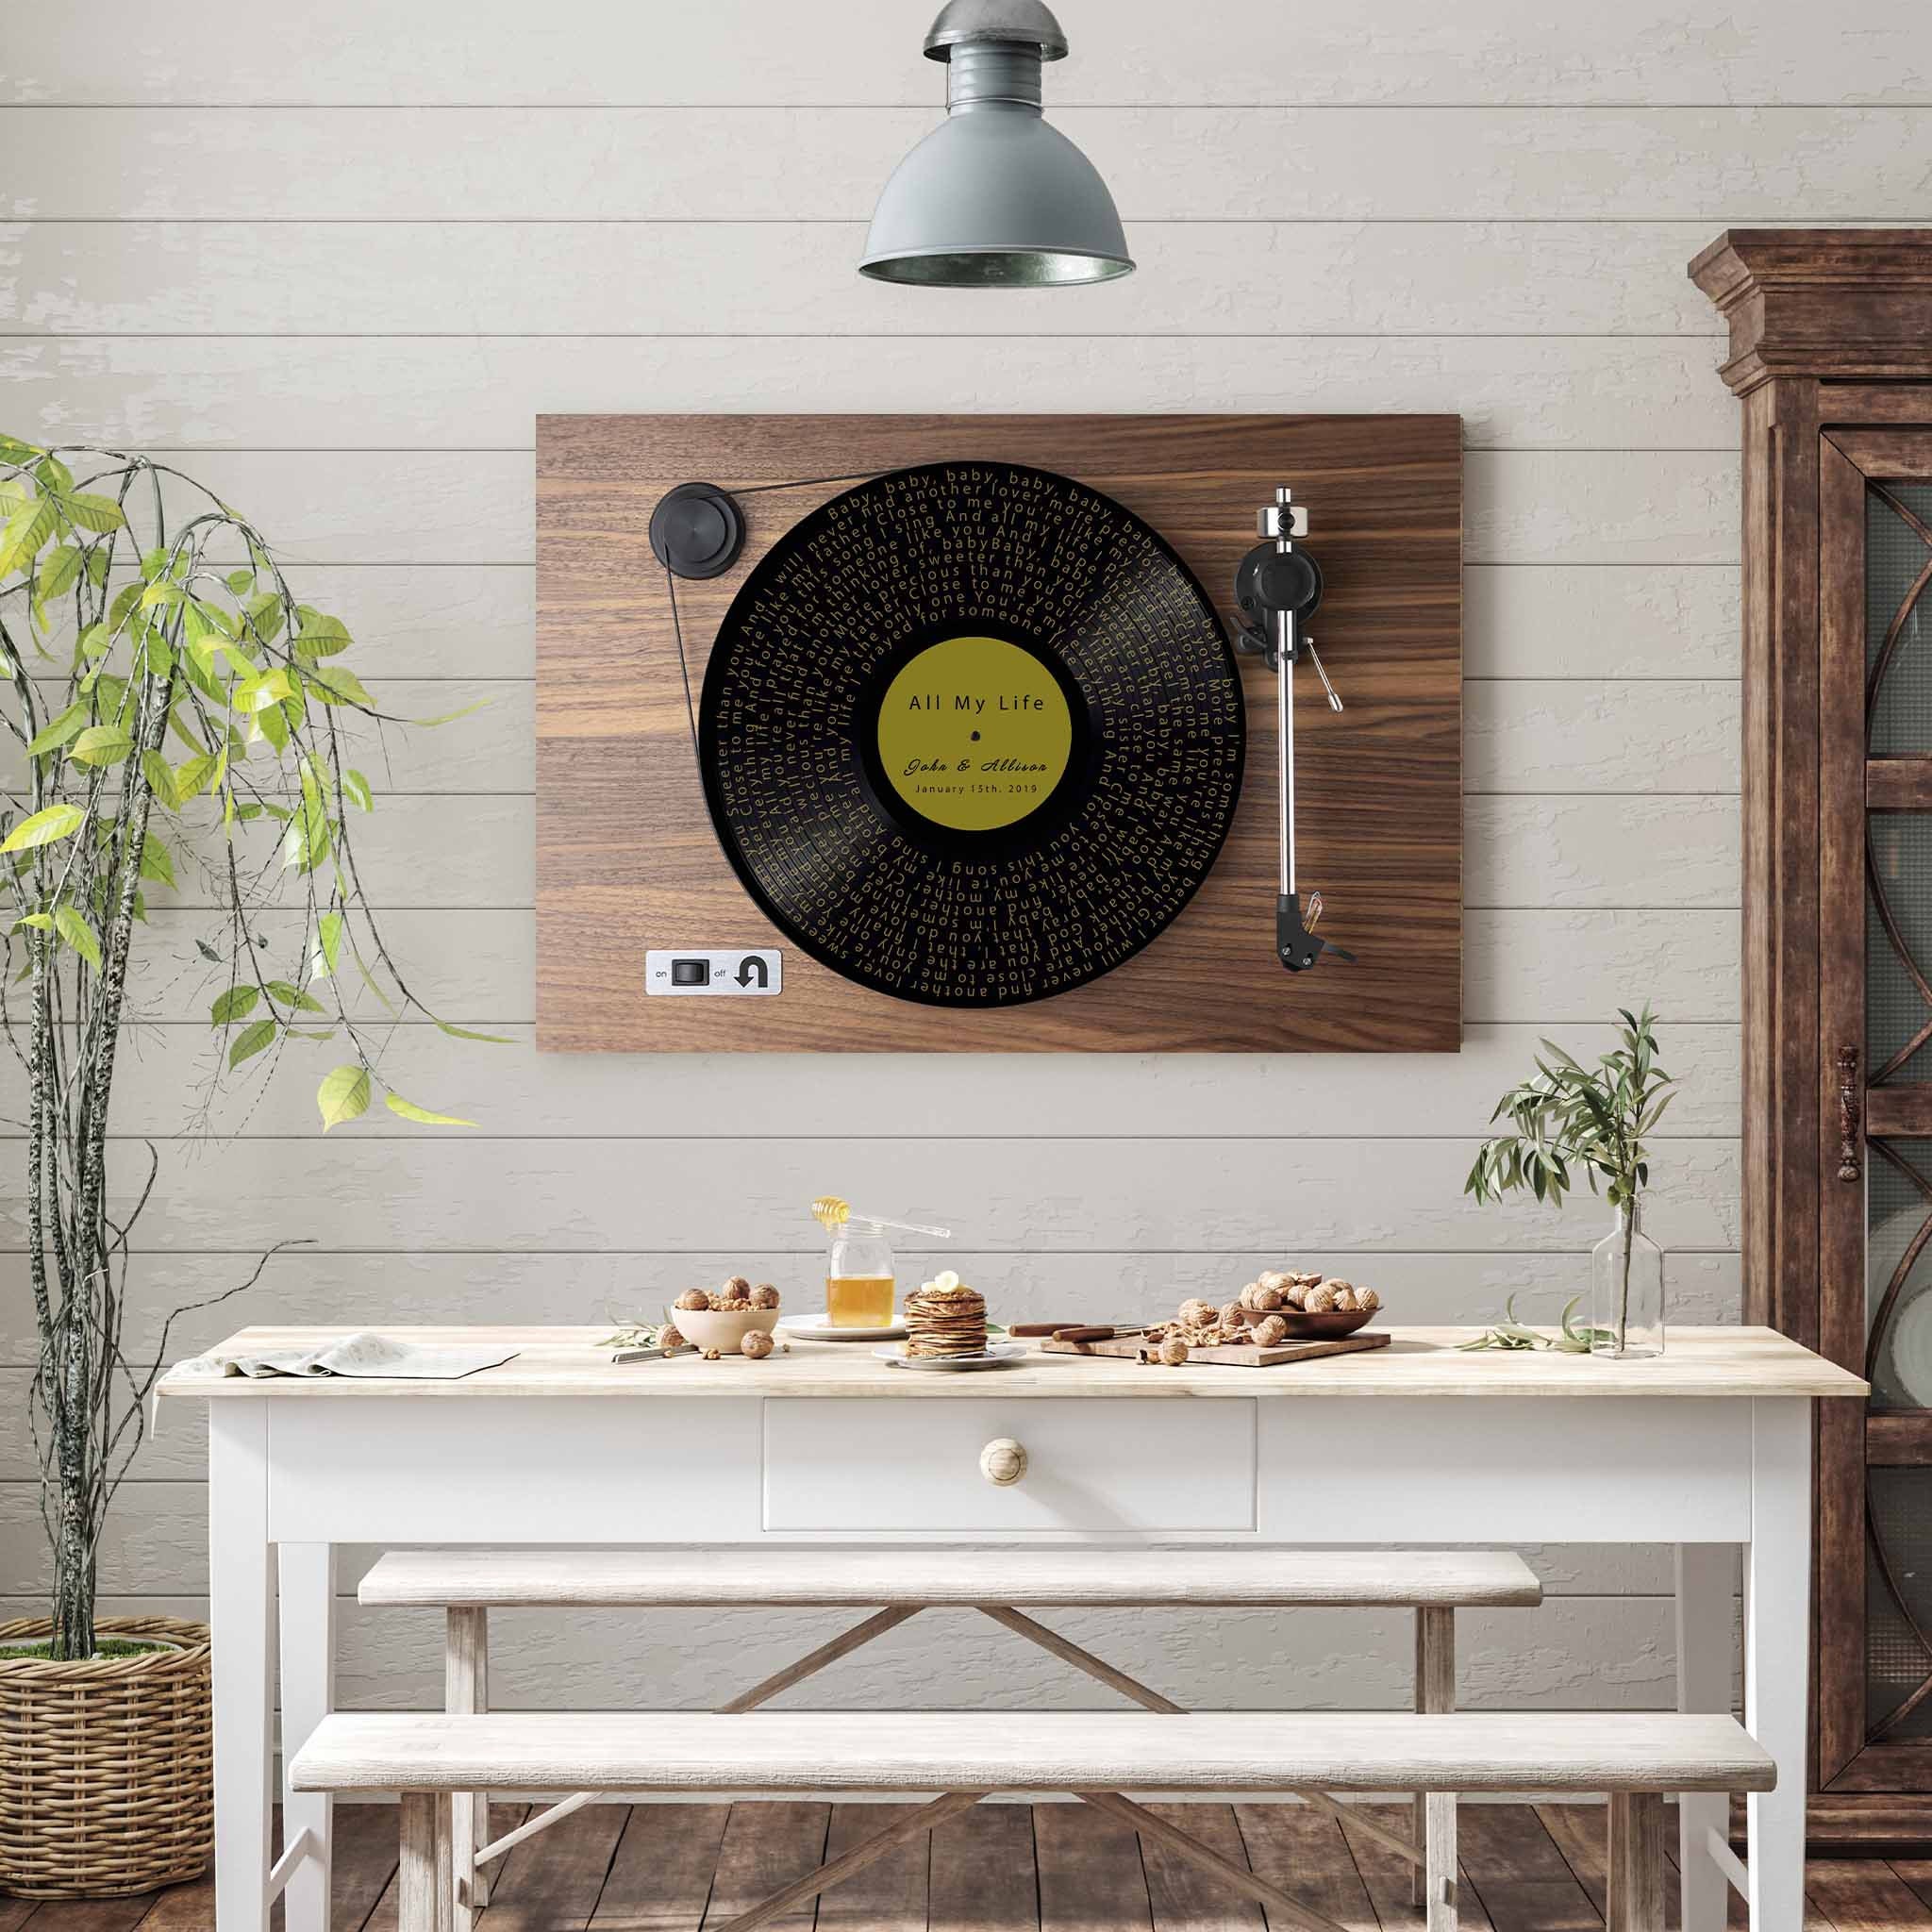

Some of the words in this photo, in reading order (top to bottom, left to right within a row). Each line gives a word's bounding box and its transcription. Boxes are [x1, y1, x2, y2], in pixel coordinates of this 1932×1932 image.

[774, 552, 804, 585] will
[807, 516, 855, 552] never
[859, 495, 895, 518] find
[904, 483, 981, 503] another
[991, 484, 1040, 503] lover
[1048, 499, 1093, 525] more
[1098, 525, 1167, 585] precious
[814, 524, 870, 562] father
[874, 503, 928, 526] Close
[894, 516, 935, 533] sing
[944, 509, 981, 522] And
[991, 512, 1015, 525] all
[1002, 502, 1062, 525] you're
[1070, 520, 1103, 546] like
[1057, 529, 1089, 553] life
[797, 568, 828, 599] this
[832, 537, 874, 567] song
[918, 552, 995, 569] sweeter
[970, 564, 1013, 580] than
[1004, 556, 1047, 577] than
[1054, 542, 1097, 575] hope
[825, 555, 900, 608] thinking
[861, 564, 910, 594] lover
[877, 567, 959, 604] precious
[1021, 575, 1055, 596] you
[1104, 562, 1158, 614] prayed
[740, 600, 766, 636] And
[766, 624, 798, 688] prayed
[796, 594, 821, 620] for
[824, 540, 899, 591] someone
[906, 528, 942, 544] like
[832, 601, 874, 639] More
[848, 598, 902, 641] father
[908, 580, 961, 600] Close
[883, 603, 923, 630] only
[974, 591, 1036, 616] You're
[1032, 594, 1087, 637] you're
[1060, 593, 1093, 624] Girl
[800, 610, 824, 638] I'm
[806, 595, 858, 659] another
[958, 608, 1043, 636] someone
[738, 629, 765, 689] you're
[761, 591, 790, 623] like
[756, 641, 774, 668] for
[860, 620, 913, 674] prayed
[727, 642, 744, 676] you
[780, 642, 804, 682] that
[812, 643, 835, 678] you
[744, 675, 762, 712] And
[788, 665, 808, 701] find
[813, 676, 833, 712] like
[1172, 654, 1194, 739] someone
[717, 686, 732, 728] than
[774, 691, 786, 715] all
[798, 685, 816, 727] than
[838, 692, 856, 725] life
[909, 694, 941, 710] All
[955, 695, 986, 714] My
[1000, 694, 1043, 710] Life
[1208, 677, 1222, 725] More
[1221, 677, 1237, 724] baby
[757, 712, 769, 744] life
[826, 701, 840, 736] you
[1129, 702, 1142, 754] close
[786, 709, 796, 764] never
[811, 722, 830, 784] you're
[1115, 716, 1129, 773] sister
[1143, 728, 1155, 762] you
[771, 724, 789, 787] you're
[824, 746, 841, 784] And
[904, 758, 947, 775] John
[958, 759, 970, 772] &
[981, 758, 1047, 772] Allison
[1097, 749, 1116, 787] And
[1168, 739, 1182, 786] same
[1181, 749, 1197, 785] like
[719, 740, 739, 817] Sweeter
[734, 763, 753, 816] Close
[744, 724, 772, 829] everything
[788, 774, 808, 809] will
[800, 738, 830, 822] precious
[916, 784, 965, 794] January
[1132, 772, 1153, 808] And
[1190, 747, 1208, 808] you're
[1200, 736, 1222, 820] precious
[764, 790, 781, 817] All
[1089, 781, 1123, 830] Close
[1150, 794, 1173, 829] way
[1168, 792, 1187, 826] you
[1172, 816, 1196, 850] like
[1189, 772, 1233, 870] something
[891, 835, 928, 863] sing
[1006, 850, 1043, 870] this
[1067, 821, 1114, 871] you're
[1099, 827, 1127, 861] will
[1130, 836, 1155, 865] too
[1145, 833, 1173, 868] And
[1177, 826, 1205, 868] than
[859, 845, 907, 885] Close
[924, 871, 960, 889] like
[951, 861, 997, 874] song
[971, 867, 1032, 890] you're
[1026, 871, 1063, 892] like
[1048, 862, 1097, 898] never
[860, 880, 958, 926] something
[865, 869, 912, 903] lover
[912, 881, 981, 901] mother
[1088, 882, 1135, 924] thank
[1147, 876, 1194, 926] better
[1151, 872, 1177, 903] you
[869, 904, 908, 930] love
[920, 897, 997, 915] another
[1006, 895, 1042, 914] find
[1006, 906, 1053, 925] baby
[1039, 904, 1080, 930] pray
[1091, 884, 1153, 937] brother
[1117, 906, 1151, 936] Girl
[786, 906, 848, 958] sweeter
[816, 915, 848, 944] like
[848, 905, 904, 943] finally
[991, 926, 1032, 941] that
[1046, 921, 1084, 945] God
[853, 941, 912, 972] you're
[876, 936, 918, 959] only
[926, 941, 966, 957] that
[998, 939, 1038, 955] that
[1007, 949, 1041, 966] you
[1048, 935, 1085, 958] And
[1081, 932, 1112, 957] you
[1100, 938, 1132, 965] will
[854, 958, 901, 986] lover
[910, 979, 987, 995] another
[986, 967, 1035, 982] close
[1041, 961, 1092, 987] never
[997, 982, 1033, 997] find
